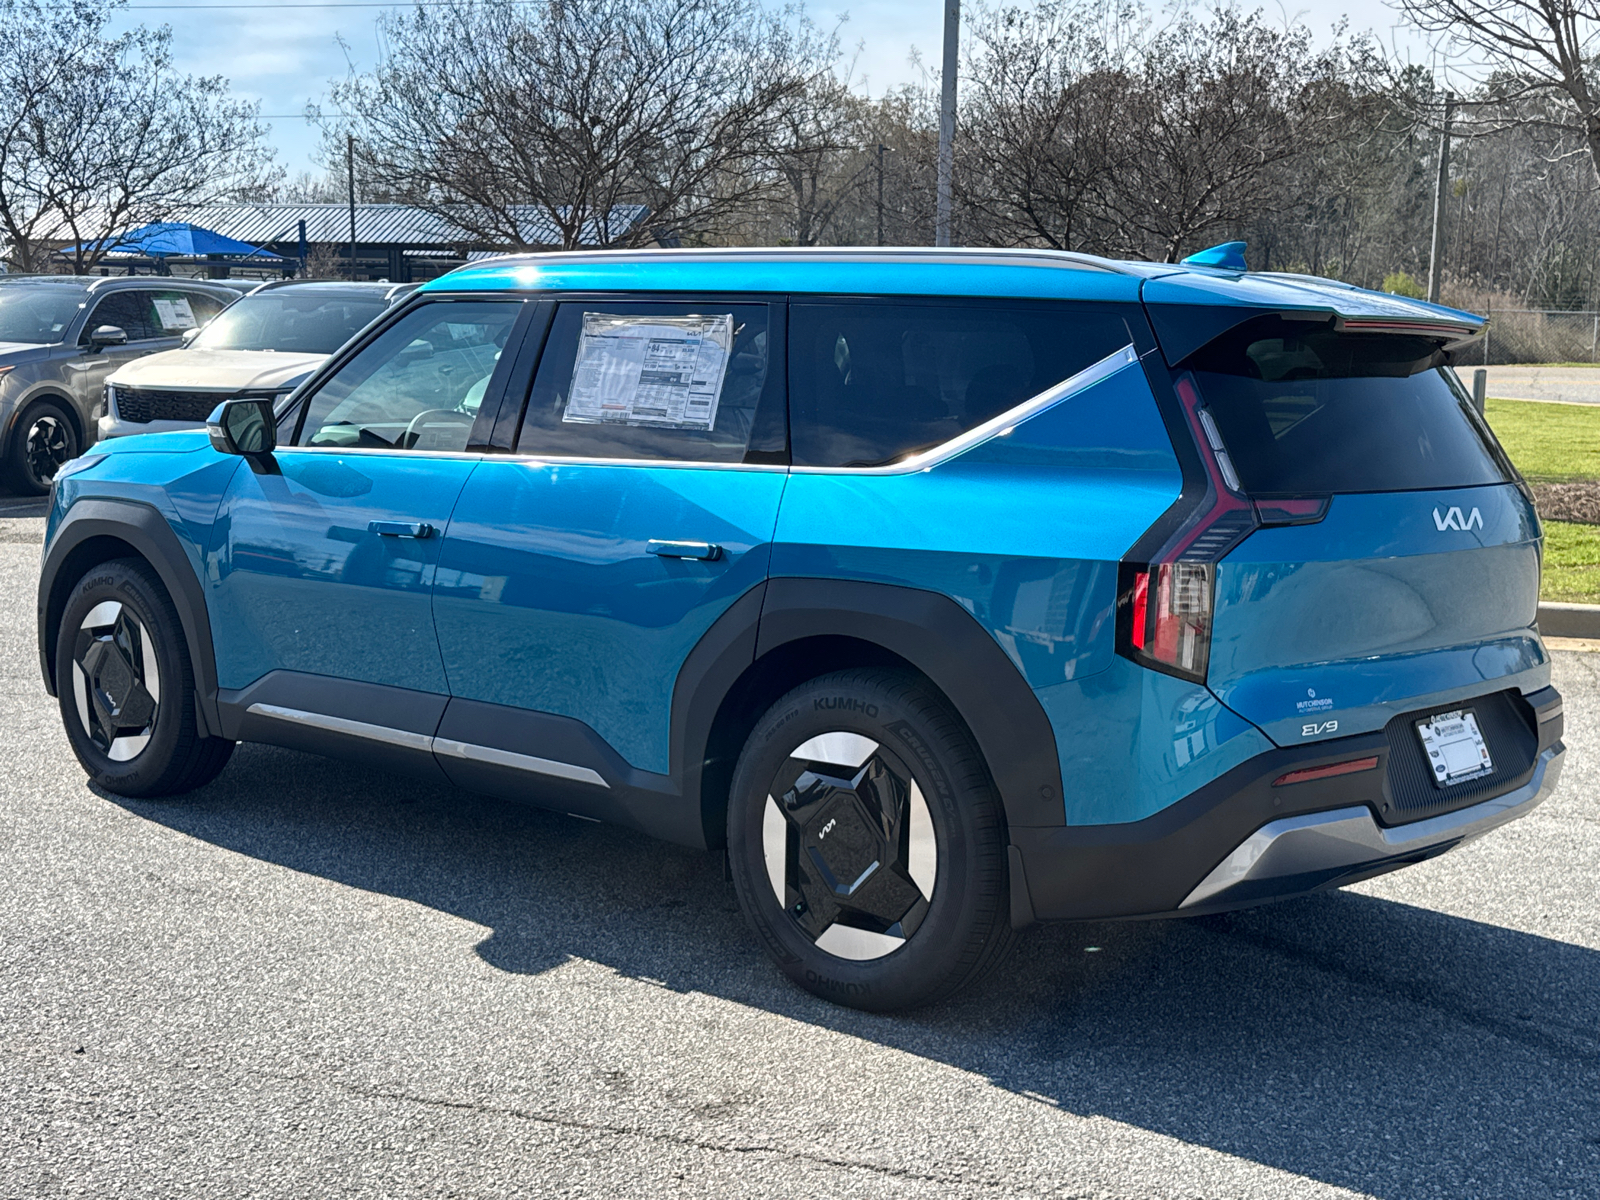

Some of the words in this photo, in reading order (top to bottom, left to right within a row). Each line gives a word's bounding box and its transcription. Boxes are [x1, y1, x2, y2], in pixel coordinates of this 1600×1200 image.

[1432, 506, 1483, 531] KIA
[82, 576, 114, 594] KUMHO
[813, 697, 880, 719] KUMHO
[1302, 720, 1338, 736] EV9
[898, 727, 949, 796] CRUGEN
